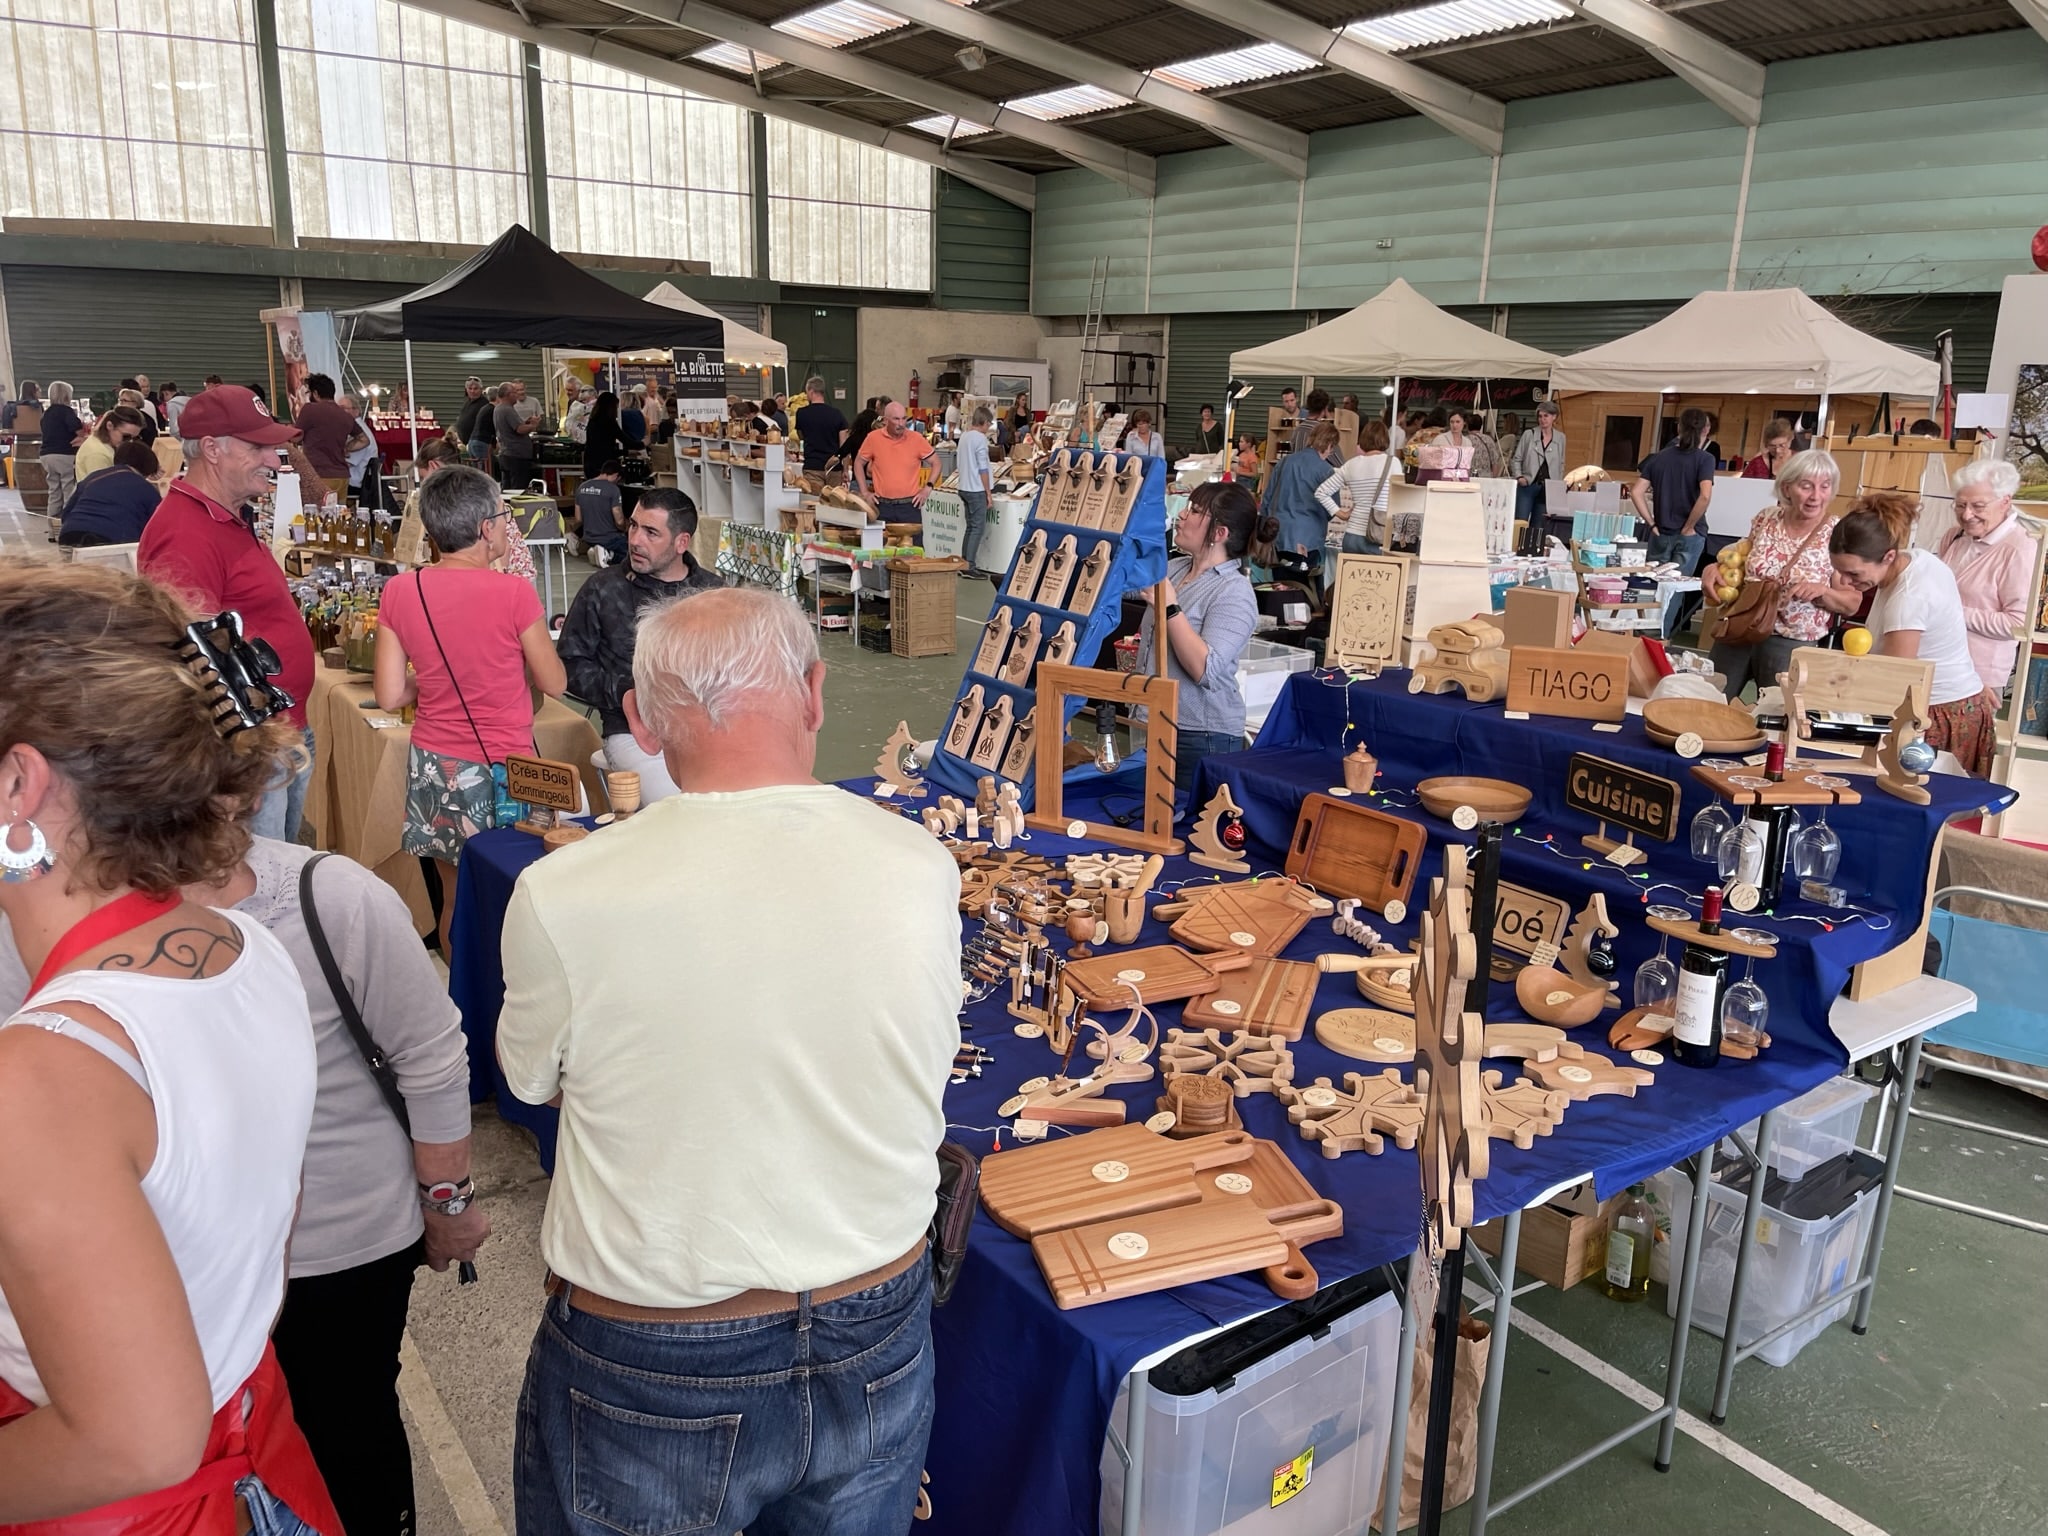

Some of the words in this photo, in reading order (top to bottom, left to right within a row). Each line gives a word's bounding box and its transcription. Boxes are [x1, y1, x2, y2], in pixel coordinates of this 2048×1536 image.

[675, 362, 687, 375] LA
[689, 362, 725, 376] BINETTE
[925, 499, 960, 518] SPIRULINE
[1348, 568, 1393, 581] AVANT
[1526, 667, 1611, 702] TIAGO
[510, 762, 538, 779] Créa
[542, 768, 568, 786] Bois
[513, 781, 570, 804] Commingeois
[1572, 768, 1663, 825] Cuisine
[1484, 896, 1544, 943] loé
